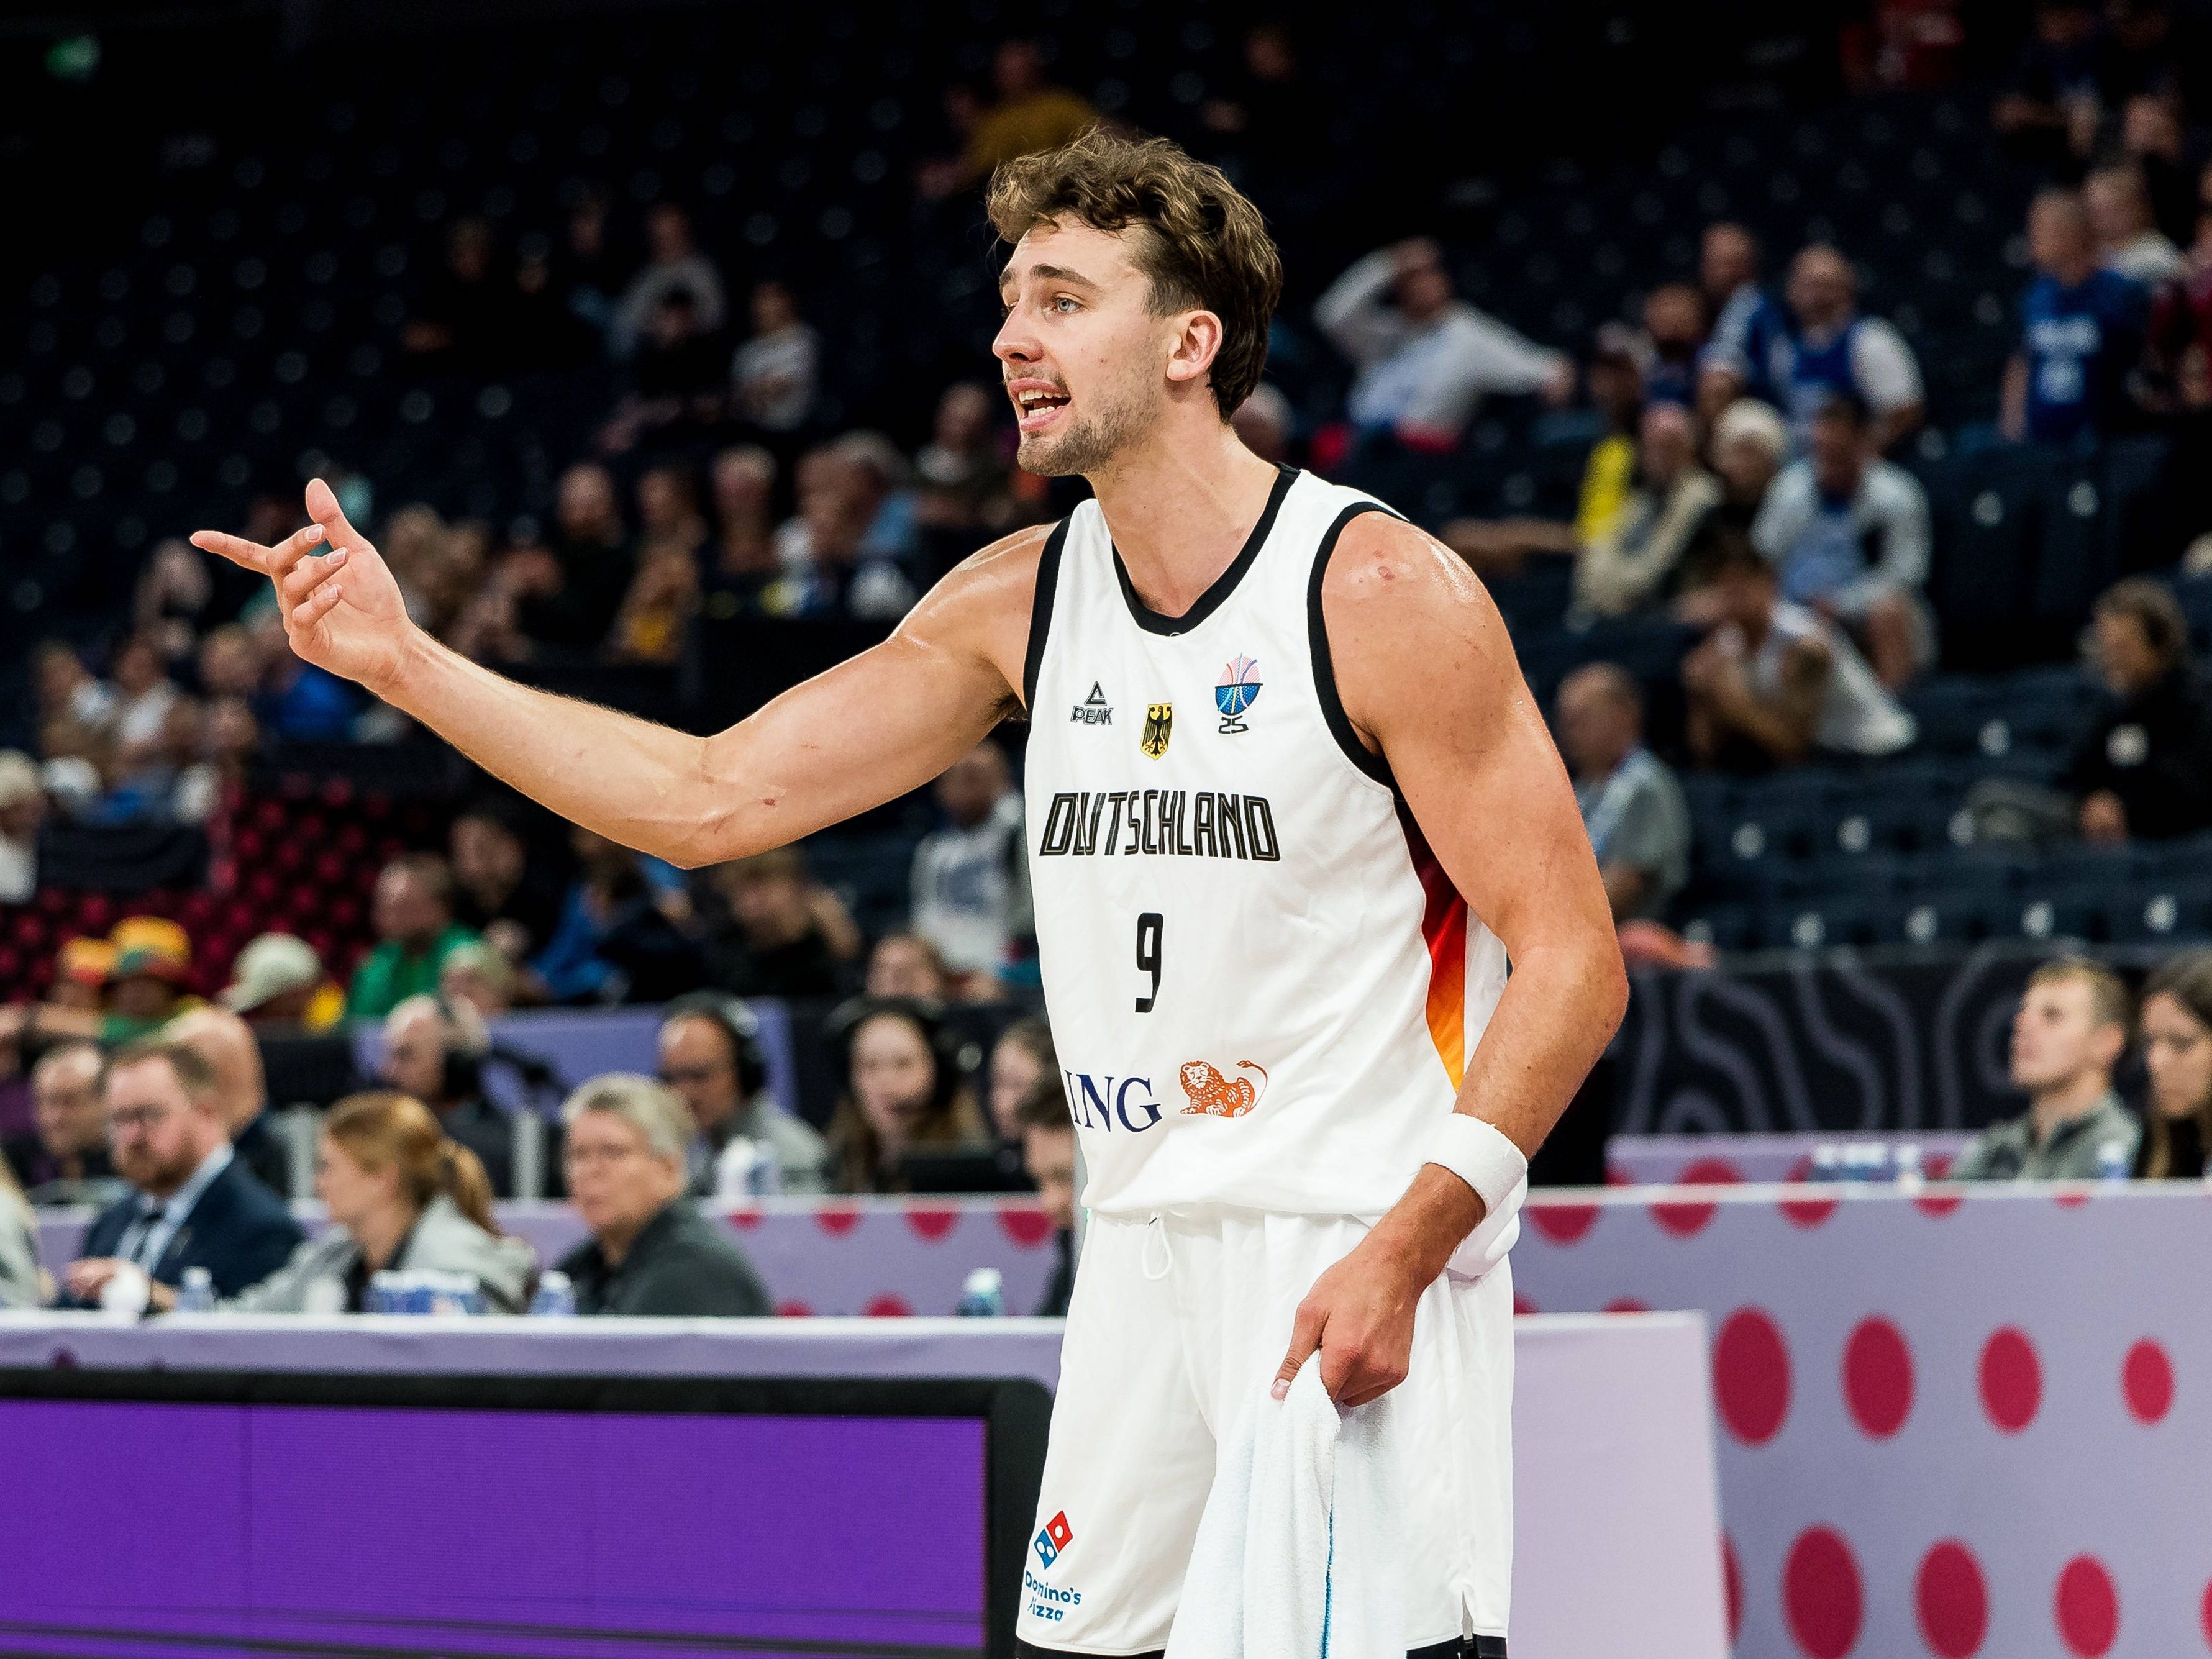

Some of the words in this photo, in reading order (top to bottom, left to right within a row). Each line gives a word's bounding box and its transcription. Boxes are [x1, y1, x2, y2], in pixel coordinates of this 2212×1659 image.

[1070, 706, 1114, 725] PEAK
[1218, 715, 1249, 734] 25
[1039, 789, 1281, 862] DUTSCHLAND
[1135, 912, 1163, 1013] 9
[1065, 1070, 1162, 1132] ING
